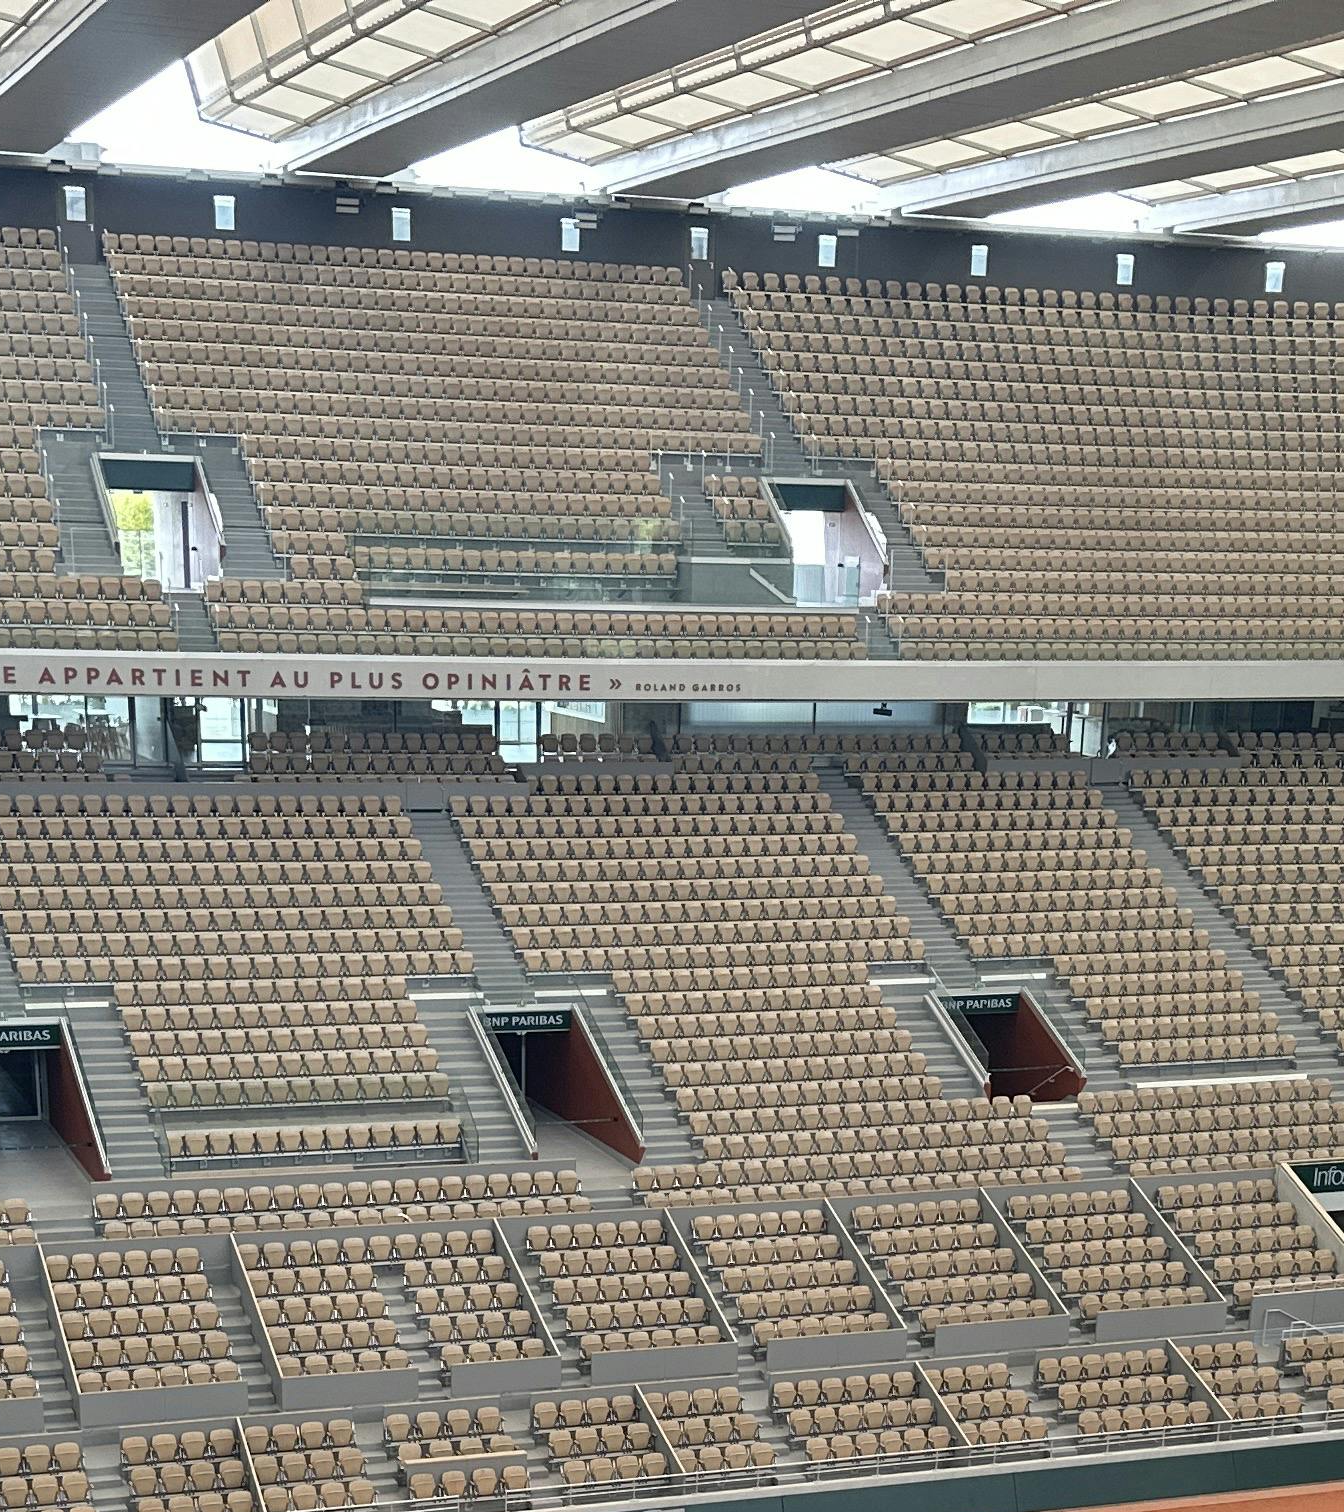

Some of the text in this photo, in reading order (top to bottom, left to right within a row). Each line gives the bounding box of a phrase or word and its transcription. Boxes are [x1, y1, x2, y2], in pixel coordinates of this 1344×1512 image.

[38, 666, 252, 688] APPARTIENT
[270, 670, 310, 689] AU
[330, 671, 404, 690] PLUS
[422, 668, 592, 692] OPINIÂTRE
[636, 682, 742, 693] ROLAND GARROS
[966, 997, 1012, 1009] PARIBAS
[512, 1014, 564, 1027] PARIBAS
